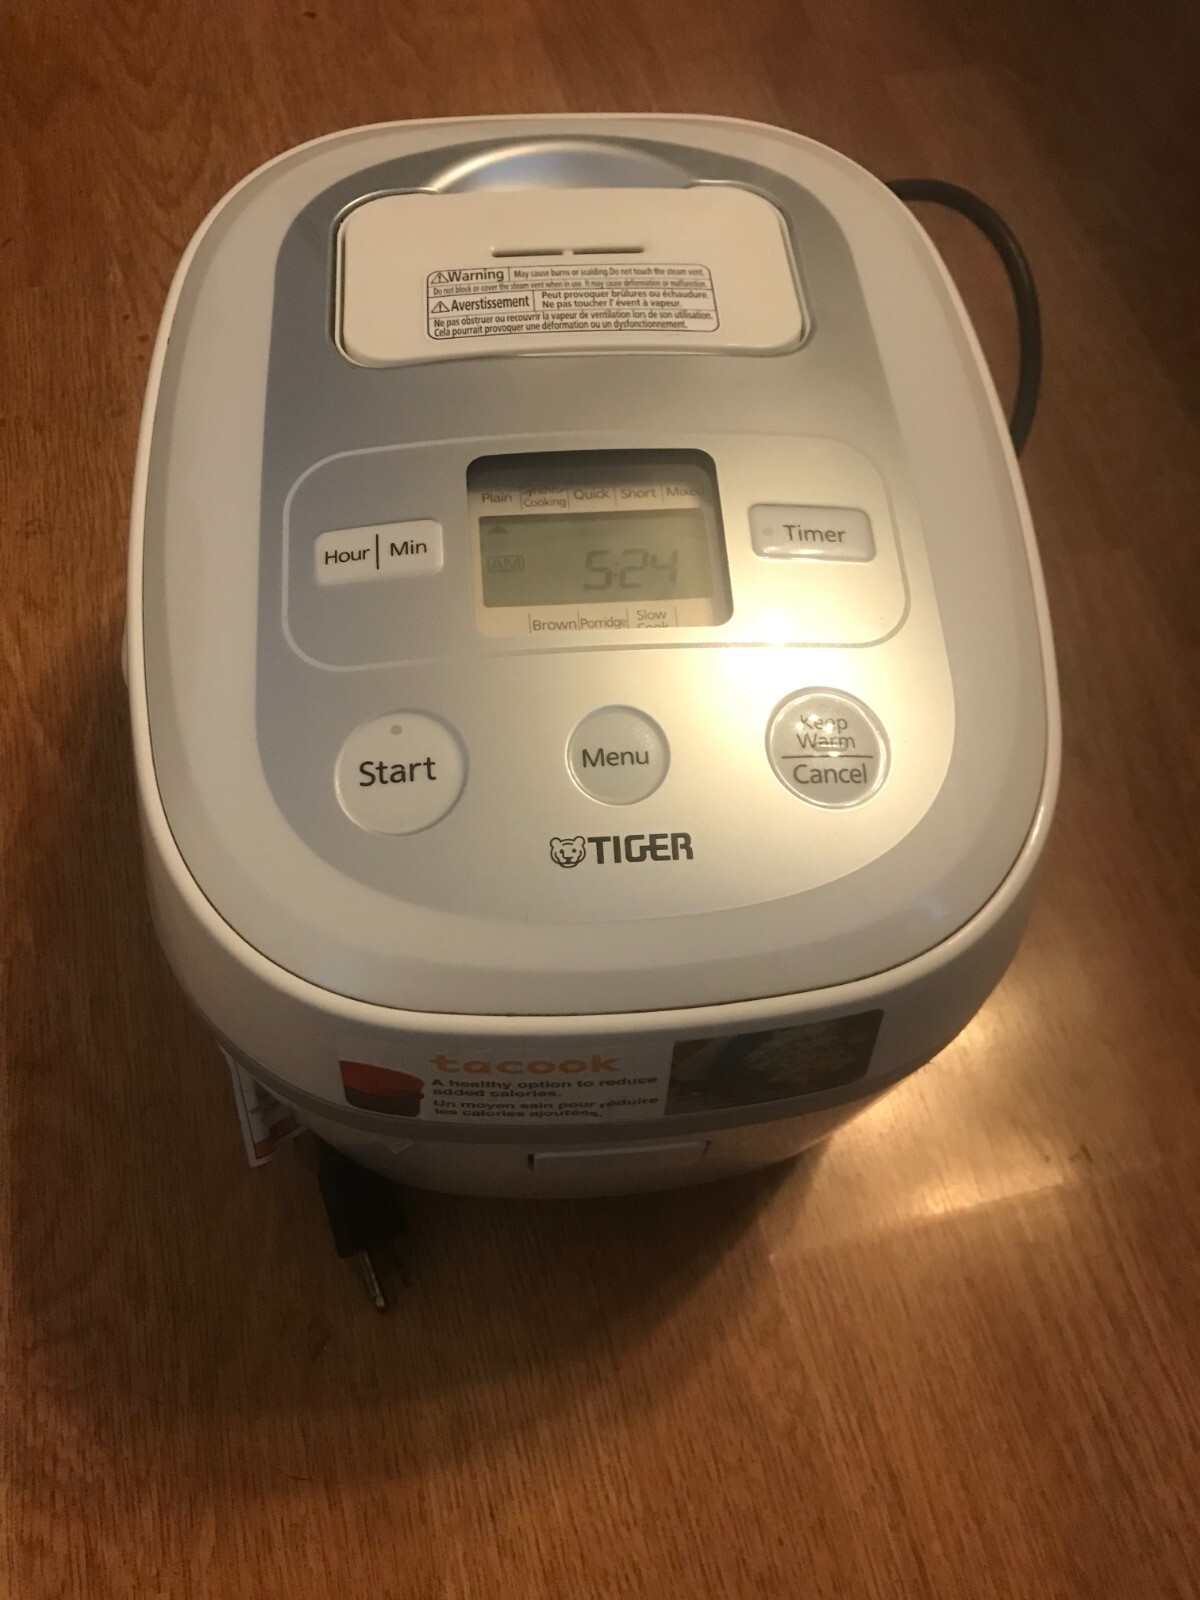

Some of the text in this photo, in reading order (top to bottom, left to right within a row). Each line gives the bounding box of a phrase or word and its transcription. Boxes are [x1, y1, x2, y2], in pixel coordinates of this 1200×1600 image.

[448, 269, 504, 282] Warning
[514, 270, 529, 278] May
[551, 269, 570, 277] burns
[433, 287, 443, 295] Do
[444, 286, 454, 294] not
[455, 285, 471, 293] block
[511, 282, 529, 290] steam
[541, 291, 562, 299] Peut
[563, 291, 609, 301] provoquer
[611, 289, 647, 298] brûlures
[649, 290, 661, 298] ou
[451, 295, 530, 312] Averstissement
[542, 300, 555, 308] Ne
[556, 300, 572, 310] pas
[574, 299, 607, 308] toucher
[642, 299, 649, 307] à
[434, 319, 445, 328] Ne
[446, 317, 460, 328] pas
[461, 314, 494, 325] obstruer
[507, 313, 541, 322] recouvrir
[542, 311, 550, 320] la
[551, 312, 578, 321] vapeur
[579, 310, 589, 319] de
[590, 309, 631, 319] ventilation
[632, 309, 647, 319] lors
[648, 309, 658, 319] de
[659, 311, 673, 319] son
[434, 327, 451, 337] Cela
[452, 325, 483, 338] pourrait
[484, 323, 525, 335] provoquer
[526, 323, 541, 331] une
[541, 320, 589, 330] déformation
[590, 321, 601, 329] ou
[602, 321, 613, 329] un
[481, 492, 513, 504] Plain
[573, 487, 611, 501] Quick
[620, 487, 657, 500] Short
[523, 496, 567, 509] Cooking
[782, 524, 846, 543] Timer
[390, 540, 428, 557] Min
[324, 548, 371, 565] Hour
[490, 555, 524, 572] AM
[583, 548, 680, 591] 5:24
[636, 609, 667, 621] Slow
[532, 619, 577, 631] Brown
[580, 616, 627, 630] Porridge
[799, 714, 848, 734] Keep
[796, 732, 856, 749] Warm
[581, 748, 650, 768] Menu
[358, 756, 437, 787] Start
[793, 762, 867, 785] Cancel
[587, 832, 694, 864] TIGER
[431, 1054, 621, 1074] tacook
[432, 1077, 658, 1090] A healthy option to reduce
[433, 1088, 562, 1098] added calories.
[460, 1101, 515, 1110] moyen
[519, 1101, 554, 1109] sain
[558, 1101, 597, 1110] pour
[600, 1097, 659, 1109] réduire
[434, 1108, 458, 1116] les
[462, 1109, 525, 1117] calories
